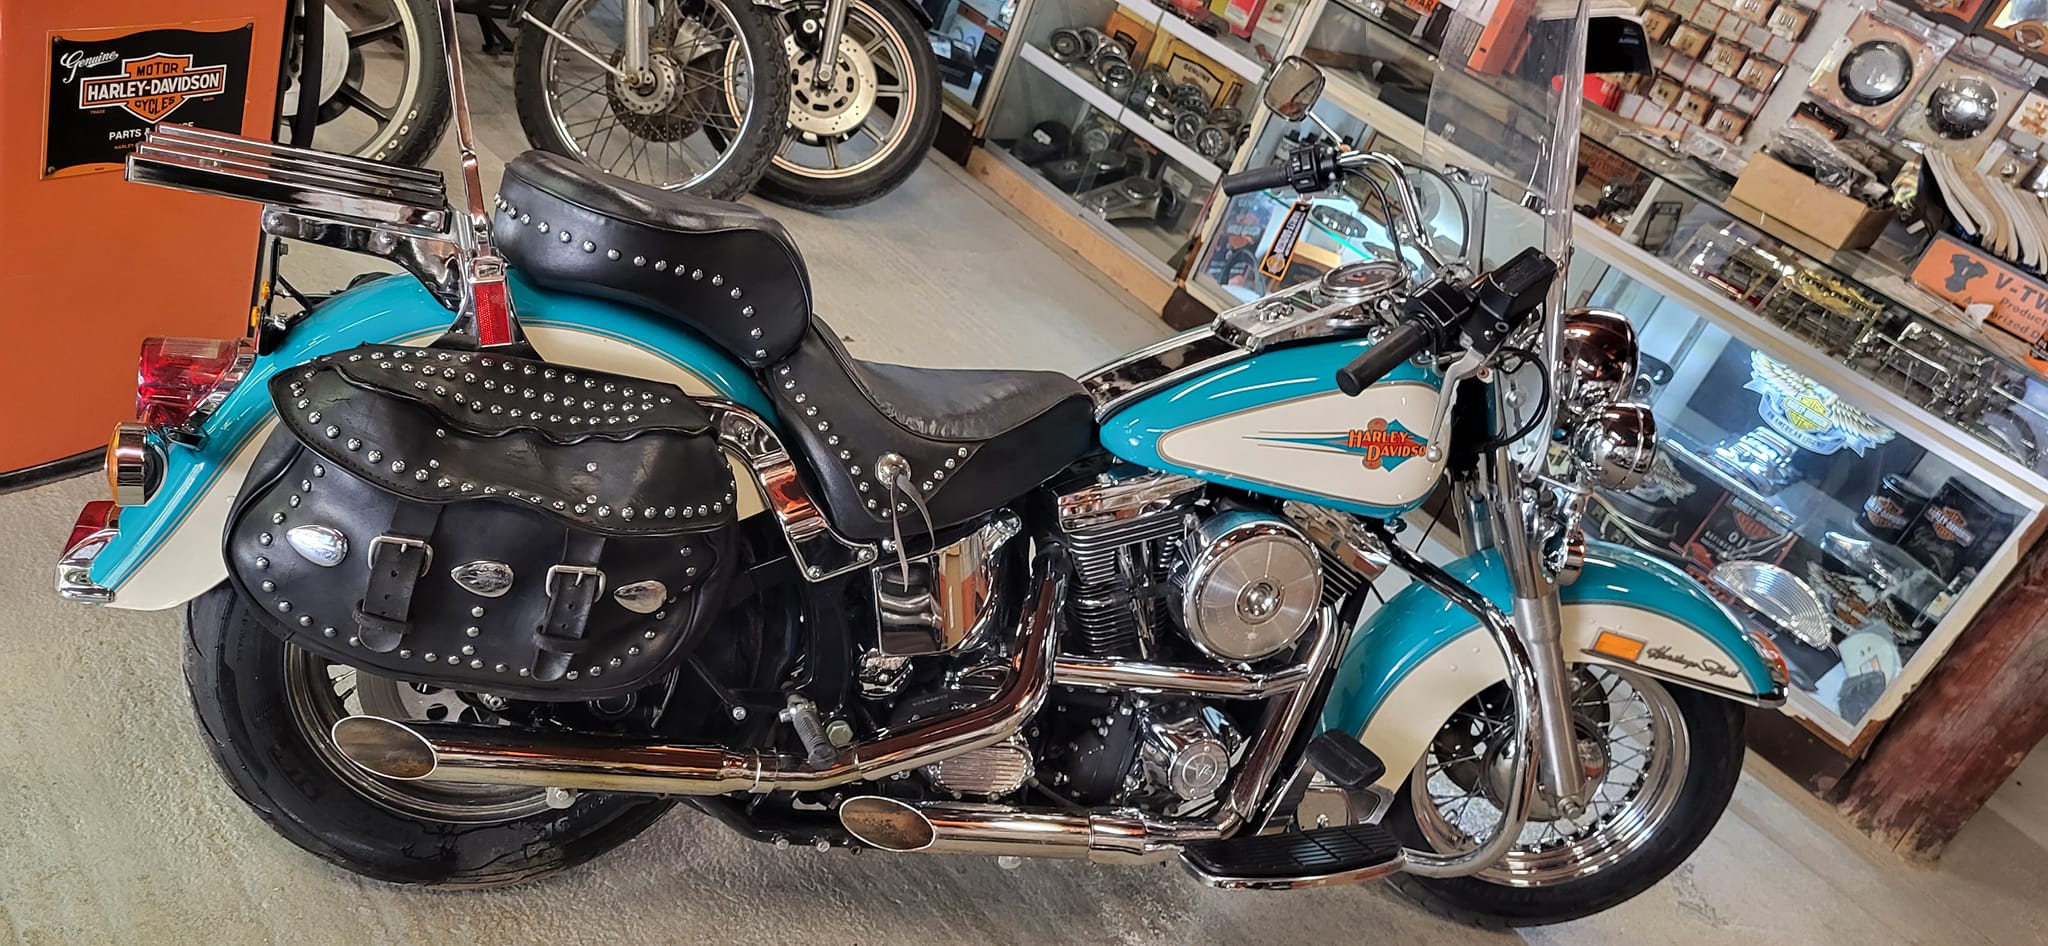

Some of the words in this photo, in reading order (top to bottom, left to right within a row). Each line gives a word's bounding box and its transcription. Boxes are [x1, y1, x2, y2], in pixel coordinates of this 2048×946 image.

[60, 50, 119, 84] Genuine
[136, 62, 179, 77] MOTOR
[87, 72, 220, 102] HARLEY-DAVIDSON
[134, 96, 175, 115] CYCLES
[108, 129, 142, 141] PARTS
[2000, 297, 2048, 329] Product
[1348, 429, 1416, 448] HARLEY-
[1366, 444, 1428, 462] DAVIDSO
